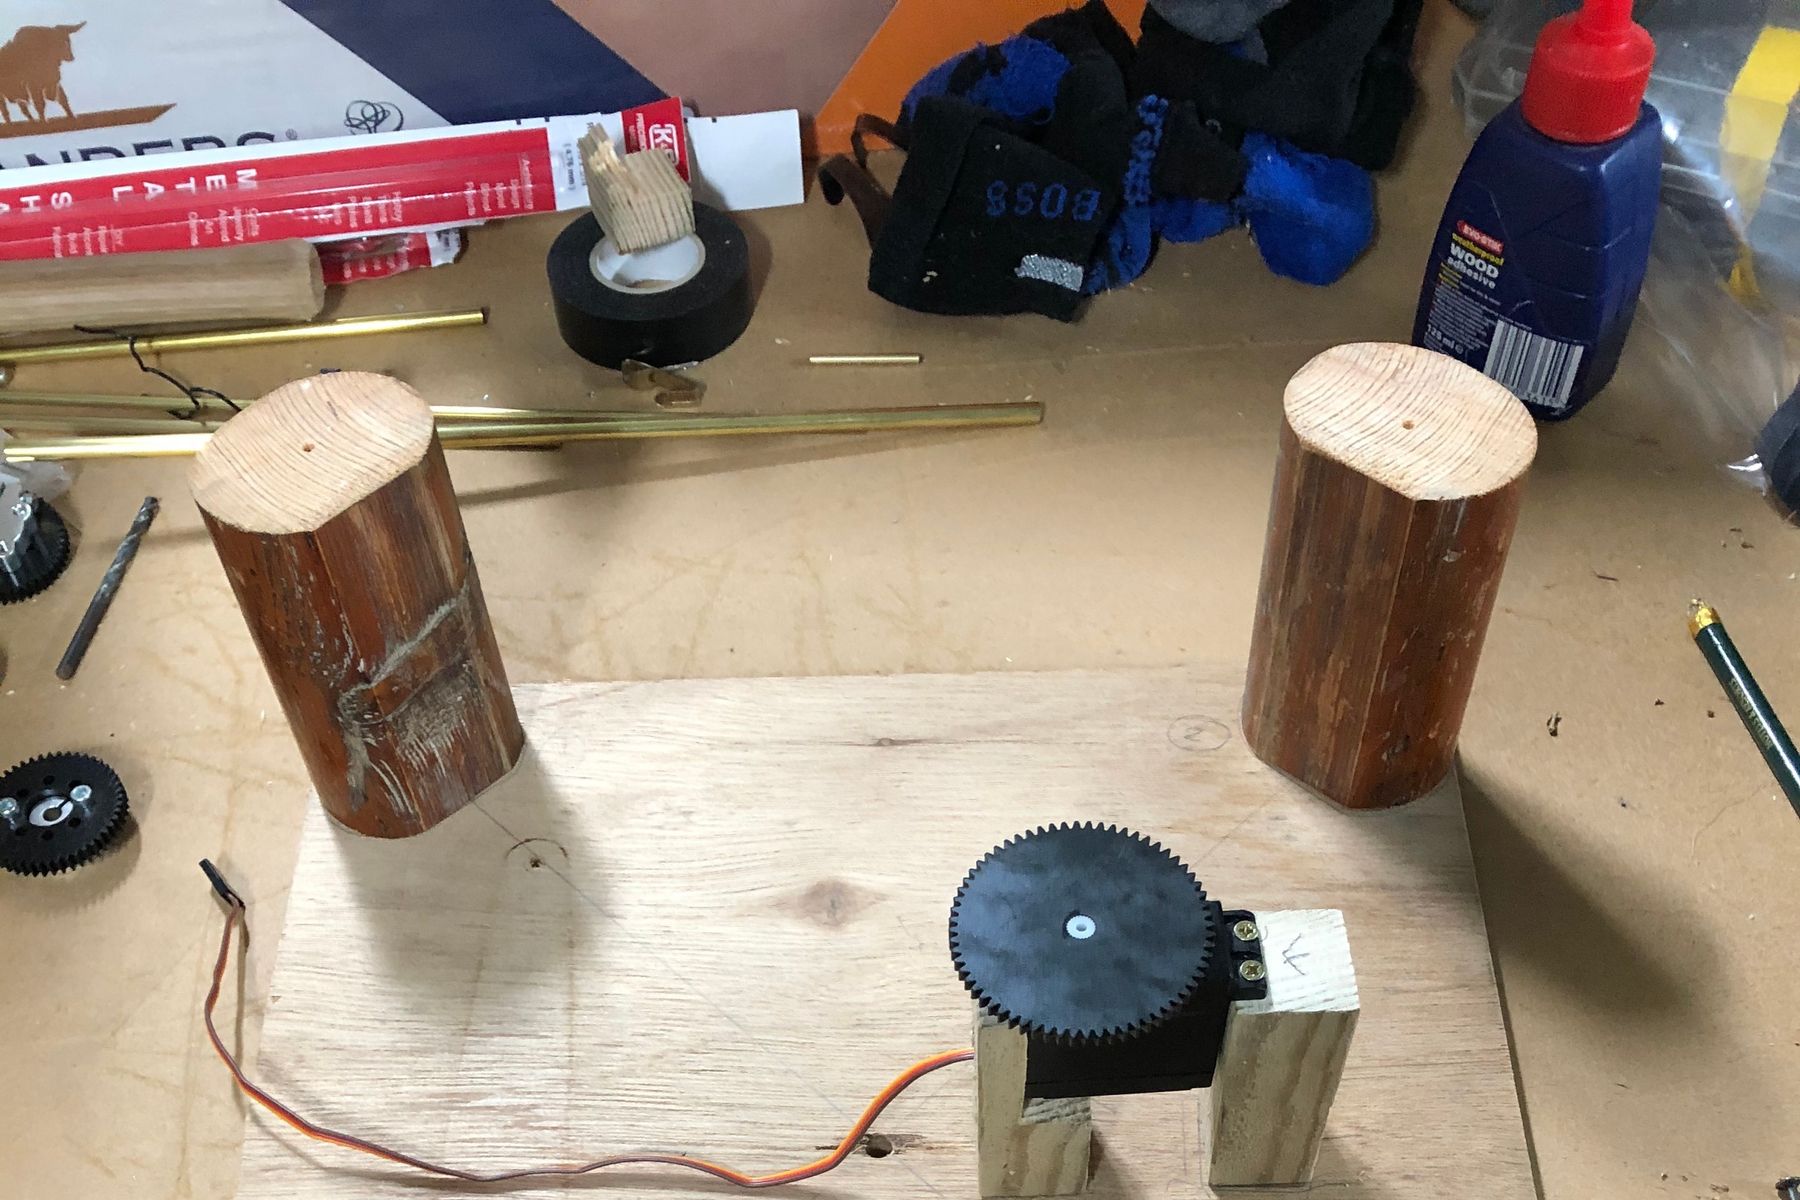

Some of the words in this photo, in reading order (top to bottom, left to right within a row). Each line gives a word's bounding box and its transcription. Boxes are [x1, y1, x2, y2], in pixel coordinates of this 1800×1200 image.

[112, 168, 258, 203] METAL
[986, 180, 1101, 221] BOSS
[1447, 256, 1496, 290] adhesive
[1450, 242, 1499, 279] WOOD
